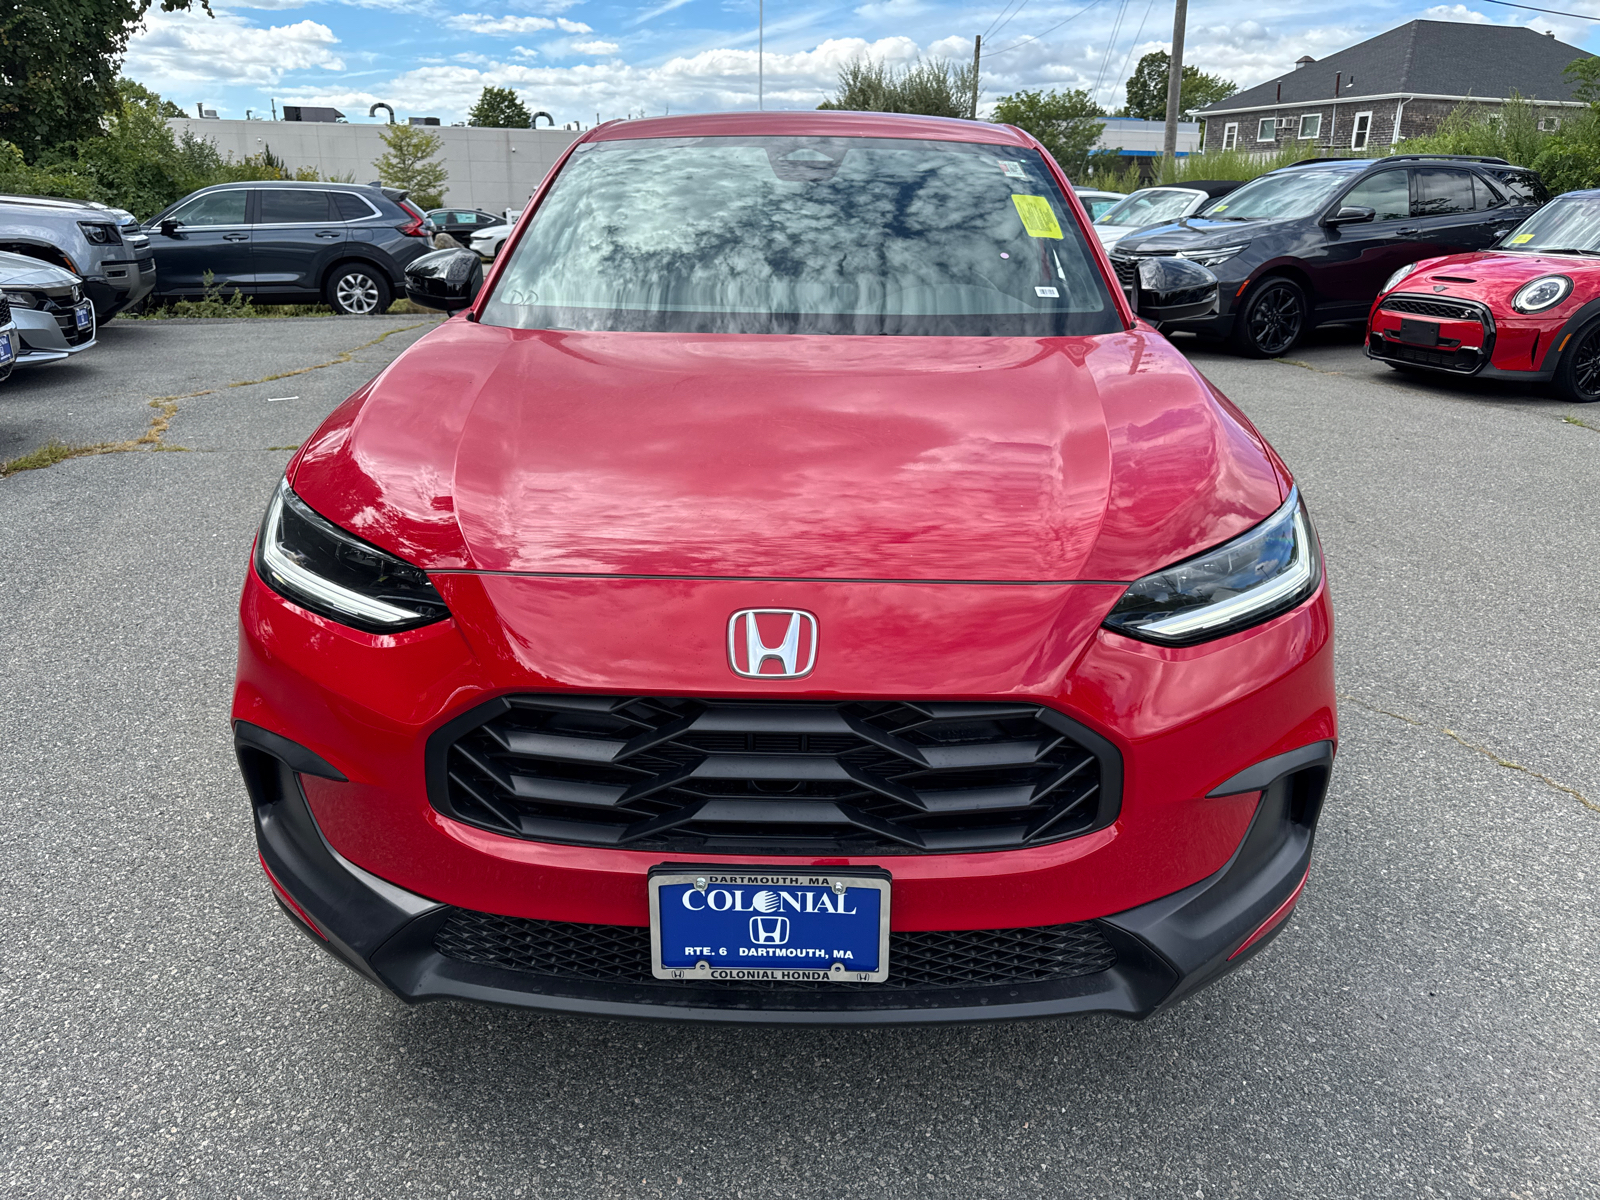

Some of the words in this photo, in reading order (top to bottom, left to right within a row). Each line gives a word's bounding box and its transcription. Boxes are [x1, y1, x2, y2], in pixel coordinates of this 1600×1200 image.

[808, 877, 830, 886] MA
[681, 888, 857, 915] COLONIAL
[684, 946, 716, 956] RTE.
[718, 947, 728, 956] 6
[739, 947, 829, 960] DARTMOUTH,
[832, 949, 854, 960] MA
[710, 970, 778, 980] COLONIAL
[781, 971, 831, 981] HONDA
